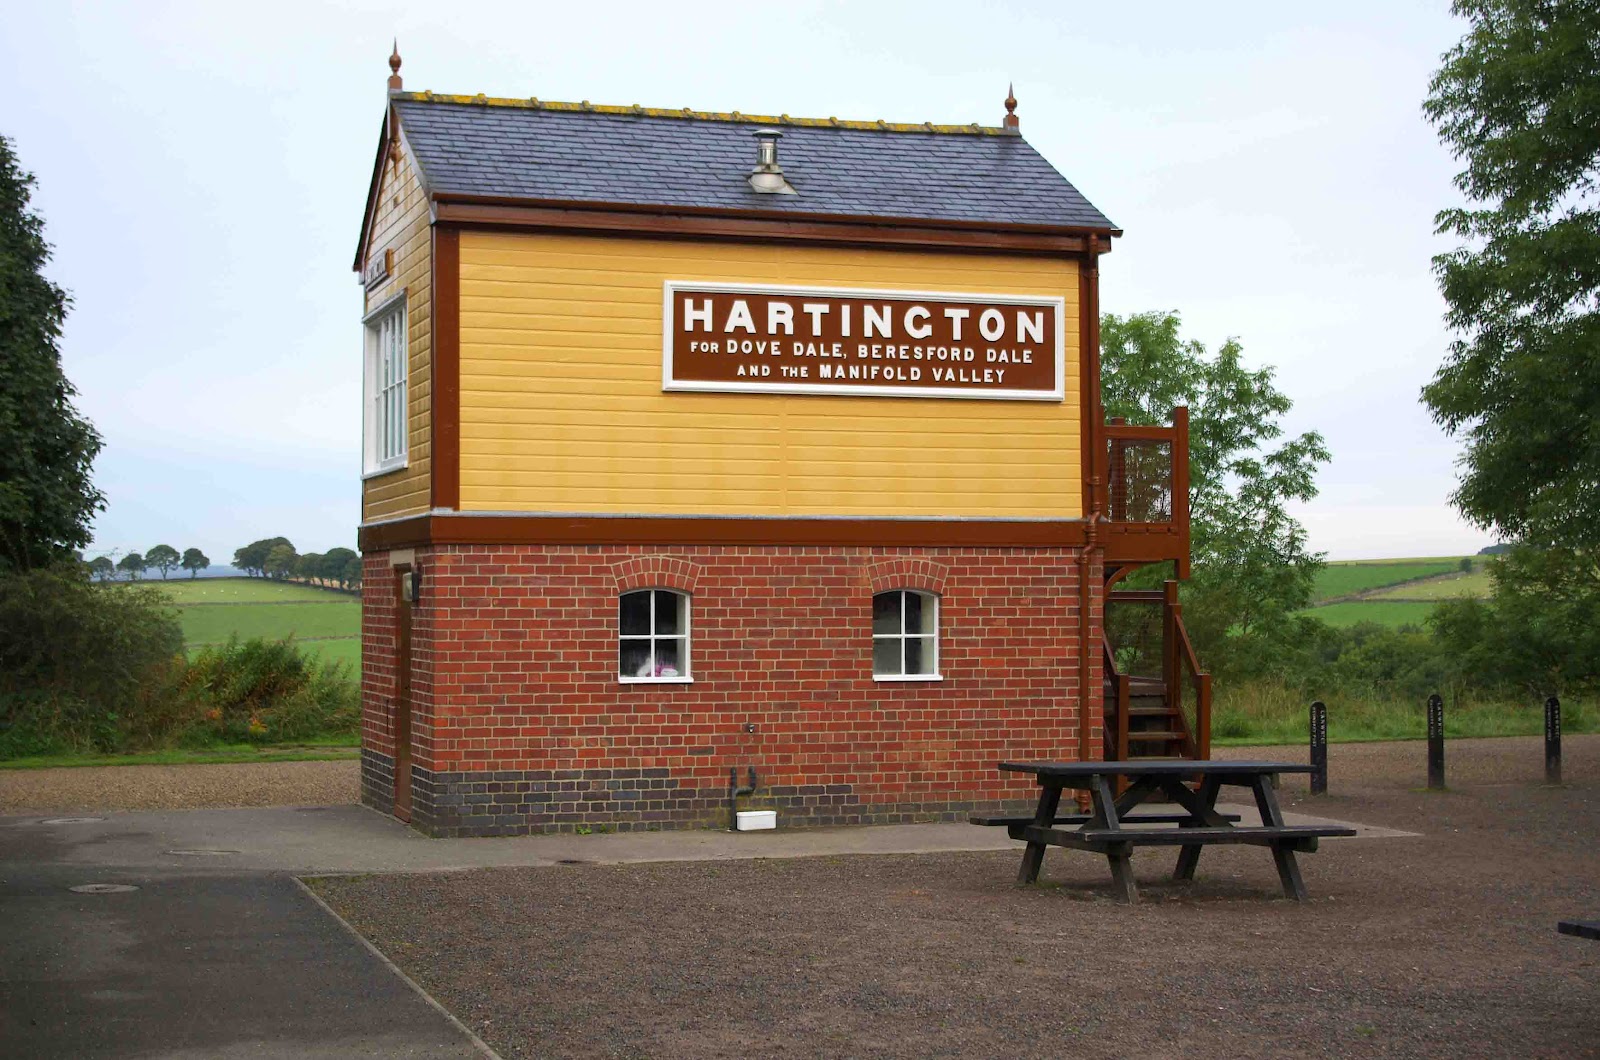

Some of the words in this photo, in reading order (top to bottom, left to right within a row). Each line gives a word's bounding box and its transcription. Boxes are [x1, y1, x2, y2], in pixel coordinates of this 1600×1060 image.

[683, 298, 1044, 344] HARTINGTON
[690, 341, 719, 353] FOR
[726, 339, 782, 355] DOVE
[793, 342, 847, 360] DALE,
[857, 344, 975, 362] BERESFORD
[986, 349, 1033, 364] DALE
[736, 364, 771, 377] AND
[780, 366, 809, 378] THE
[819, 364, 921, 381] MANIFOLD
[931, 367, 1005, 384] VALLEY
